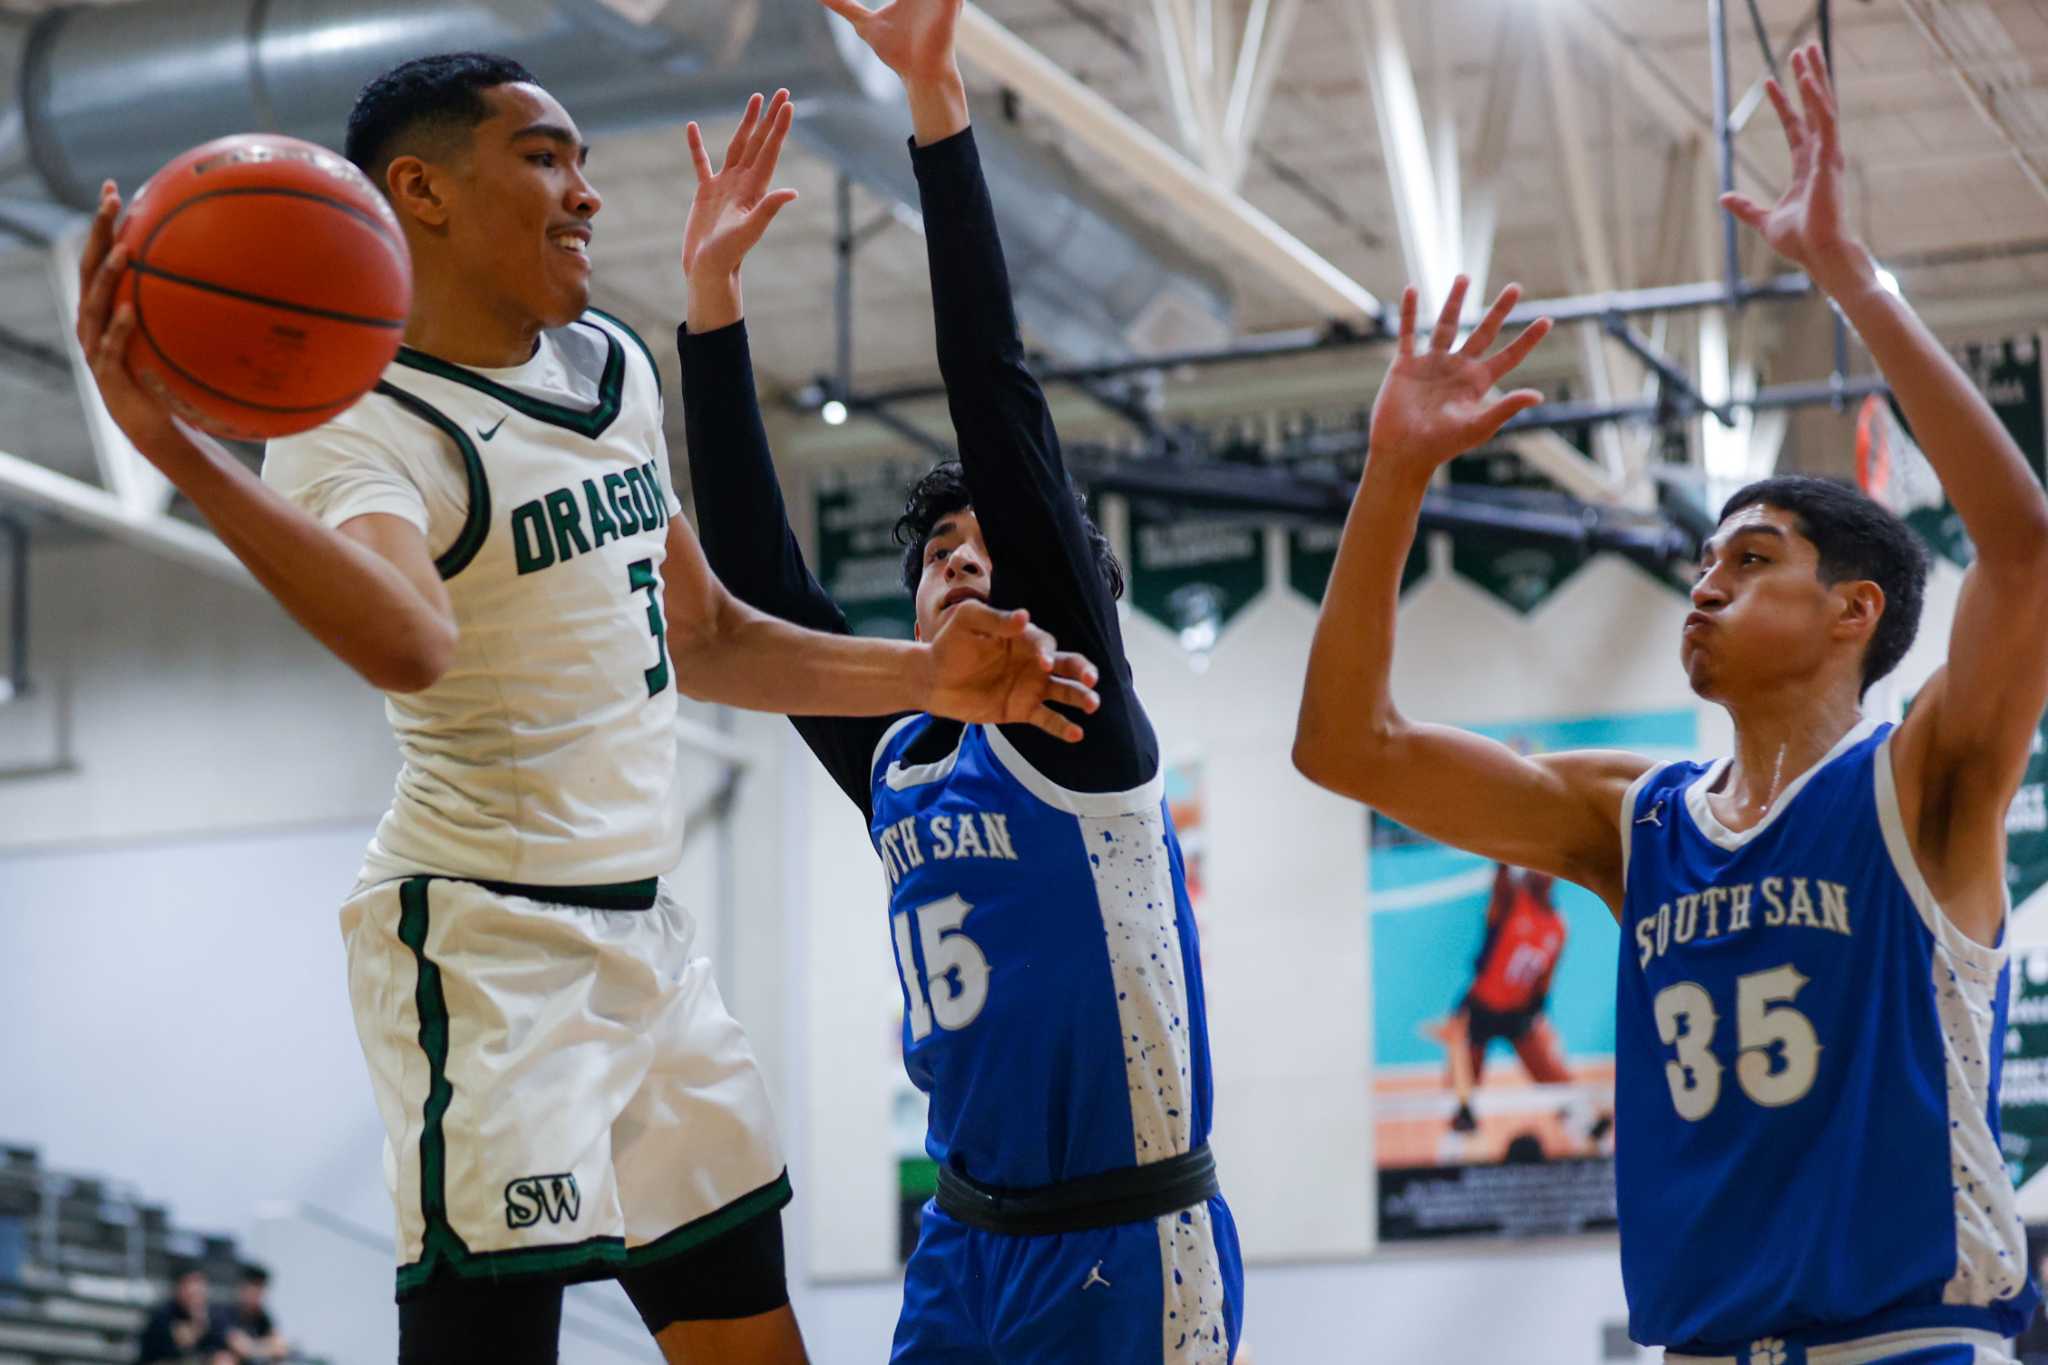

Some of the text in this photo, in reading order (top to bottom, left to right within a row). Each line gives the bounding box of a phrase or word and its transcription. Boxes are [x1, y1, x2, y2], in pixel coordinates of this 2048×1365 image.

[627, 557, 669, 698] 3
[930, 812, 1019, 861] SAN
[893, 892, 993, 1044] 15
[1635, 884, 1754, 973] SOUTH
[1761, 876, 1852, 936] SAN
[1654, 963, 1825, 1122] 35
[505, 1172, 581, 1229] SW
